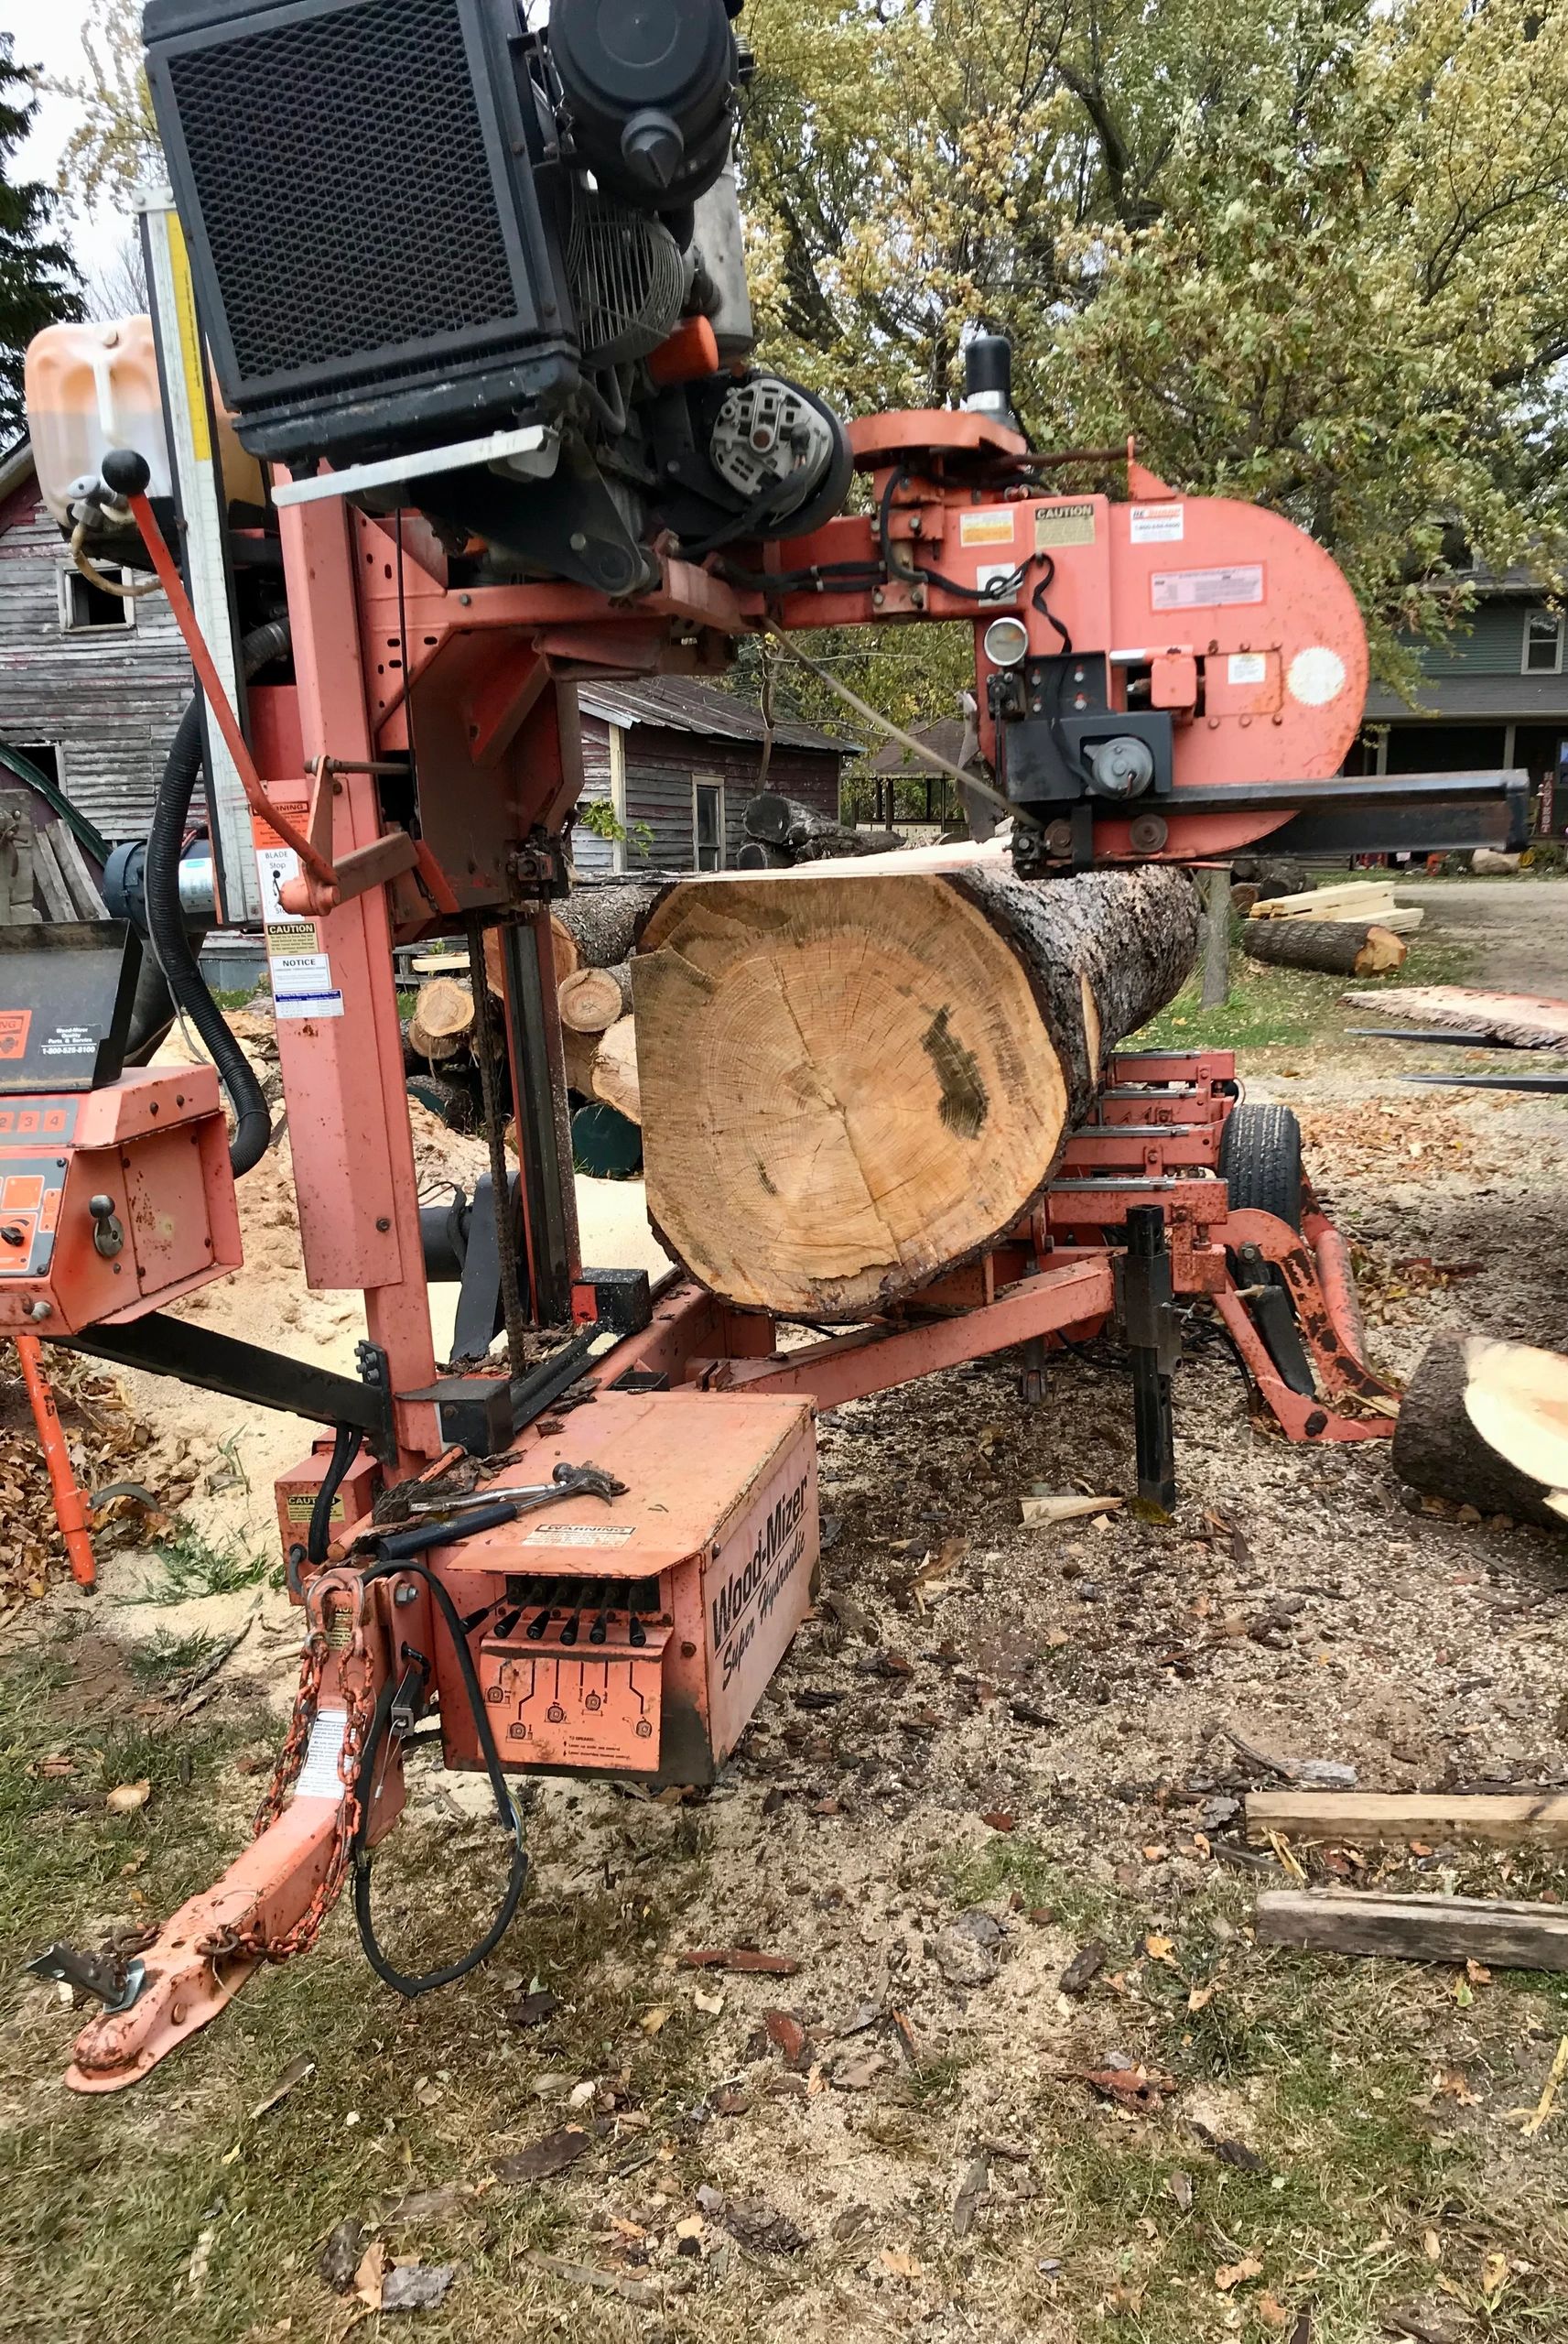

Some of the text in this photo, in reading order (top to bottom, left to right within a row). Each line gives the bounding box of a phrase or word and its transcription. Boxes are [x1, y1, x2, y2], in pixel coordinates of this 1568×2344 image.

[1036, 505, 1094, 520] CAUTION
[1541, 772, 1553, 832] HARVEST
[269, 924, 313, 934] CAUTION
[282, 959, 316, 967] NOTICE
[25, 1116, 34, 1127] 3
[50, 1115, 59, 1126] 4
[712, 1474, 807, 1652] Wood-Mizer
[722, 1530, 806, 1692] Super Hydraulic
